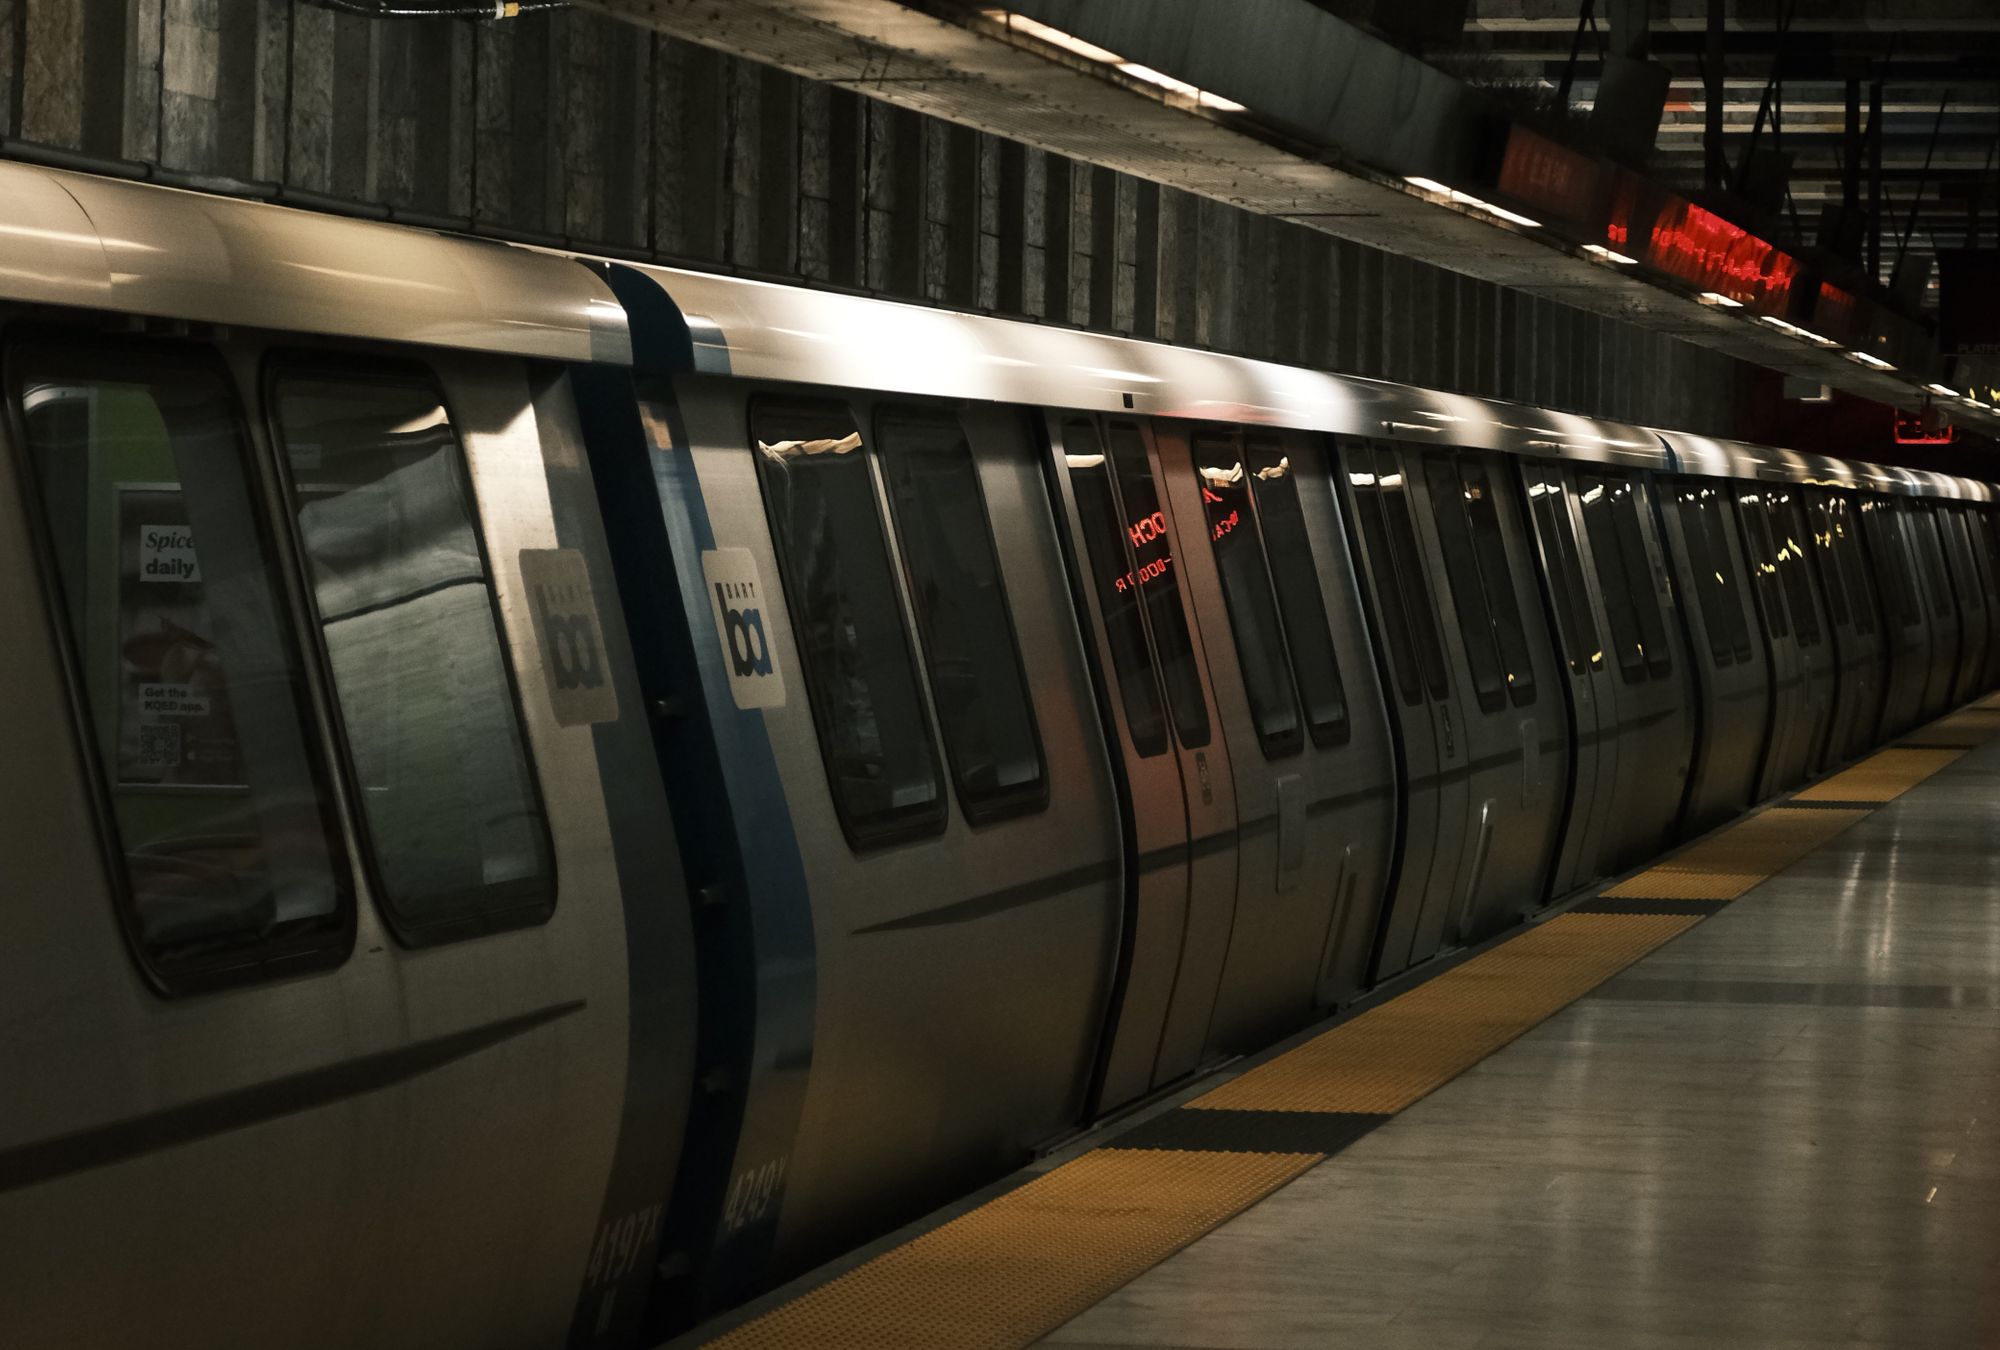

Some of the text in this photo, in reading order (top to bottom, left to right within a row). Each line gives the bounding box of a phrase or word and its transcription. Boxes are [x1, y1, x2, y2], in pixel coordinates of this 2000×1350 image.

[146, 558, 194, 579] daily
[726, 582, 756, 600] BART
[144, 687, 188, 698] Get the
[144, 700, 177, 712] KQED
